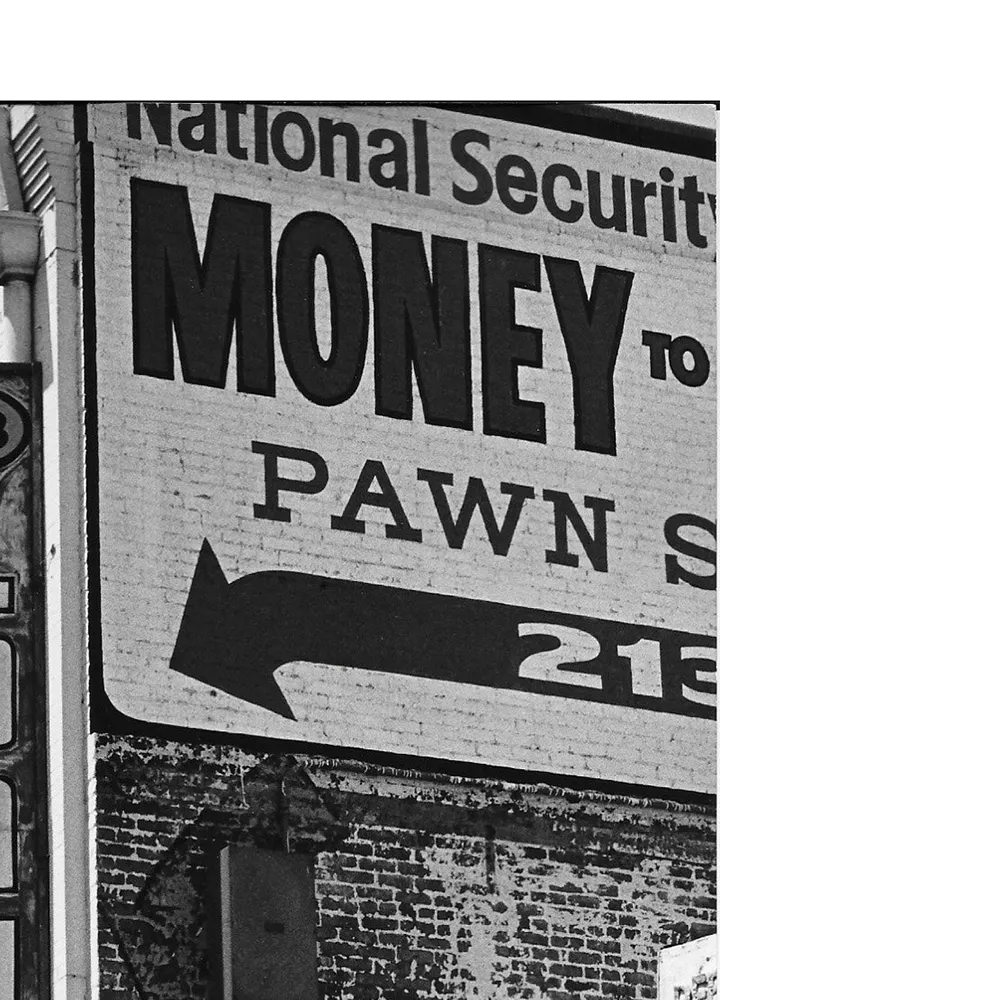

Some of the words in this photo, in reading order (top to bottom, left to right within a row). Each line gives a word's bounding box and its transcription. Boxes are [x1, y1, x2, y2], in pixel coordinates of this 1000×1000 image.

[124, 104, 431, 197] National
[450, 128, 716, 249] Securit
[130, 176, 635, 456] MONEY
[642, 330, 710, 387] TO
[251, 440, 616, 573] PAWN
